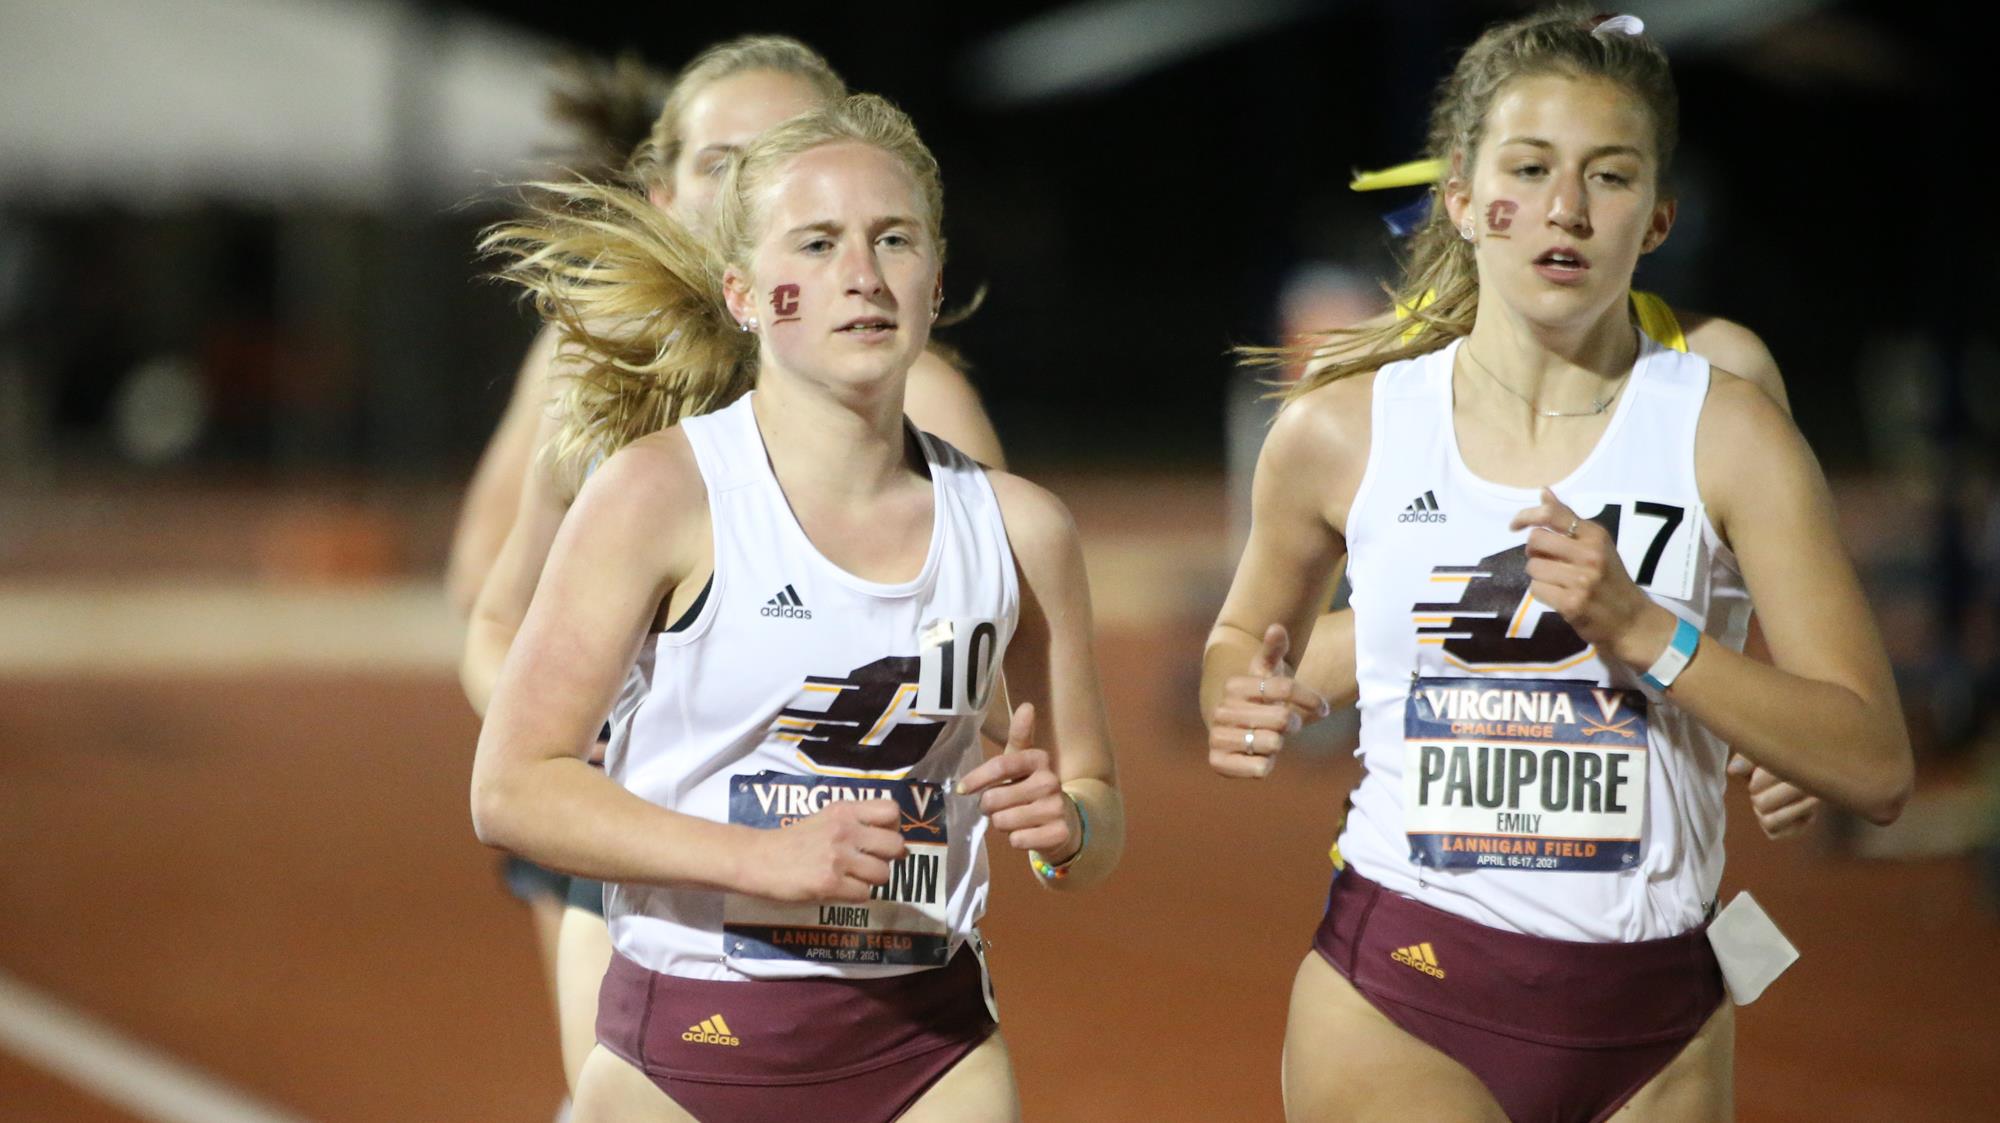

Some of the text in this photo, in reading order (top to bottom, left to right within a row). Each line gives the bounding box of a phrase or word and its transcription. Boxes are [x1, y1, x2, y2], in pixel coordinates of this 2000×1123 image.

[768, 284, 800, 316] C
[1397, 509, 1447, 524] adidas
[760, 604, 812, 620] adidas
[937, 622, 997, 711] 10
[1424, 688, 1576, 724] VIRGINIA
[1451, 723, 1553, 739] CHALLENGE
[1418, 745, 1630, 814] PAUPORE
[1496, 811, 1542, 835] EMILY
[1441, 836, 1597, 858] LANNIGAN FIELD
[1476, 855, 1505, 866] APRIL
[1535, 857, 1558, 869] 2021
[818, 905, 870, 928] LAUREN
[772, 929, 913, 950] LANNIGAN FIELD
[805, 947, 833, 959] APRIL
[860, 951, 880, 961] 2021
[1390, 951, 1445, 979] adidas
[681, 1031, 740, 1047] adidas
